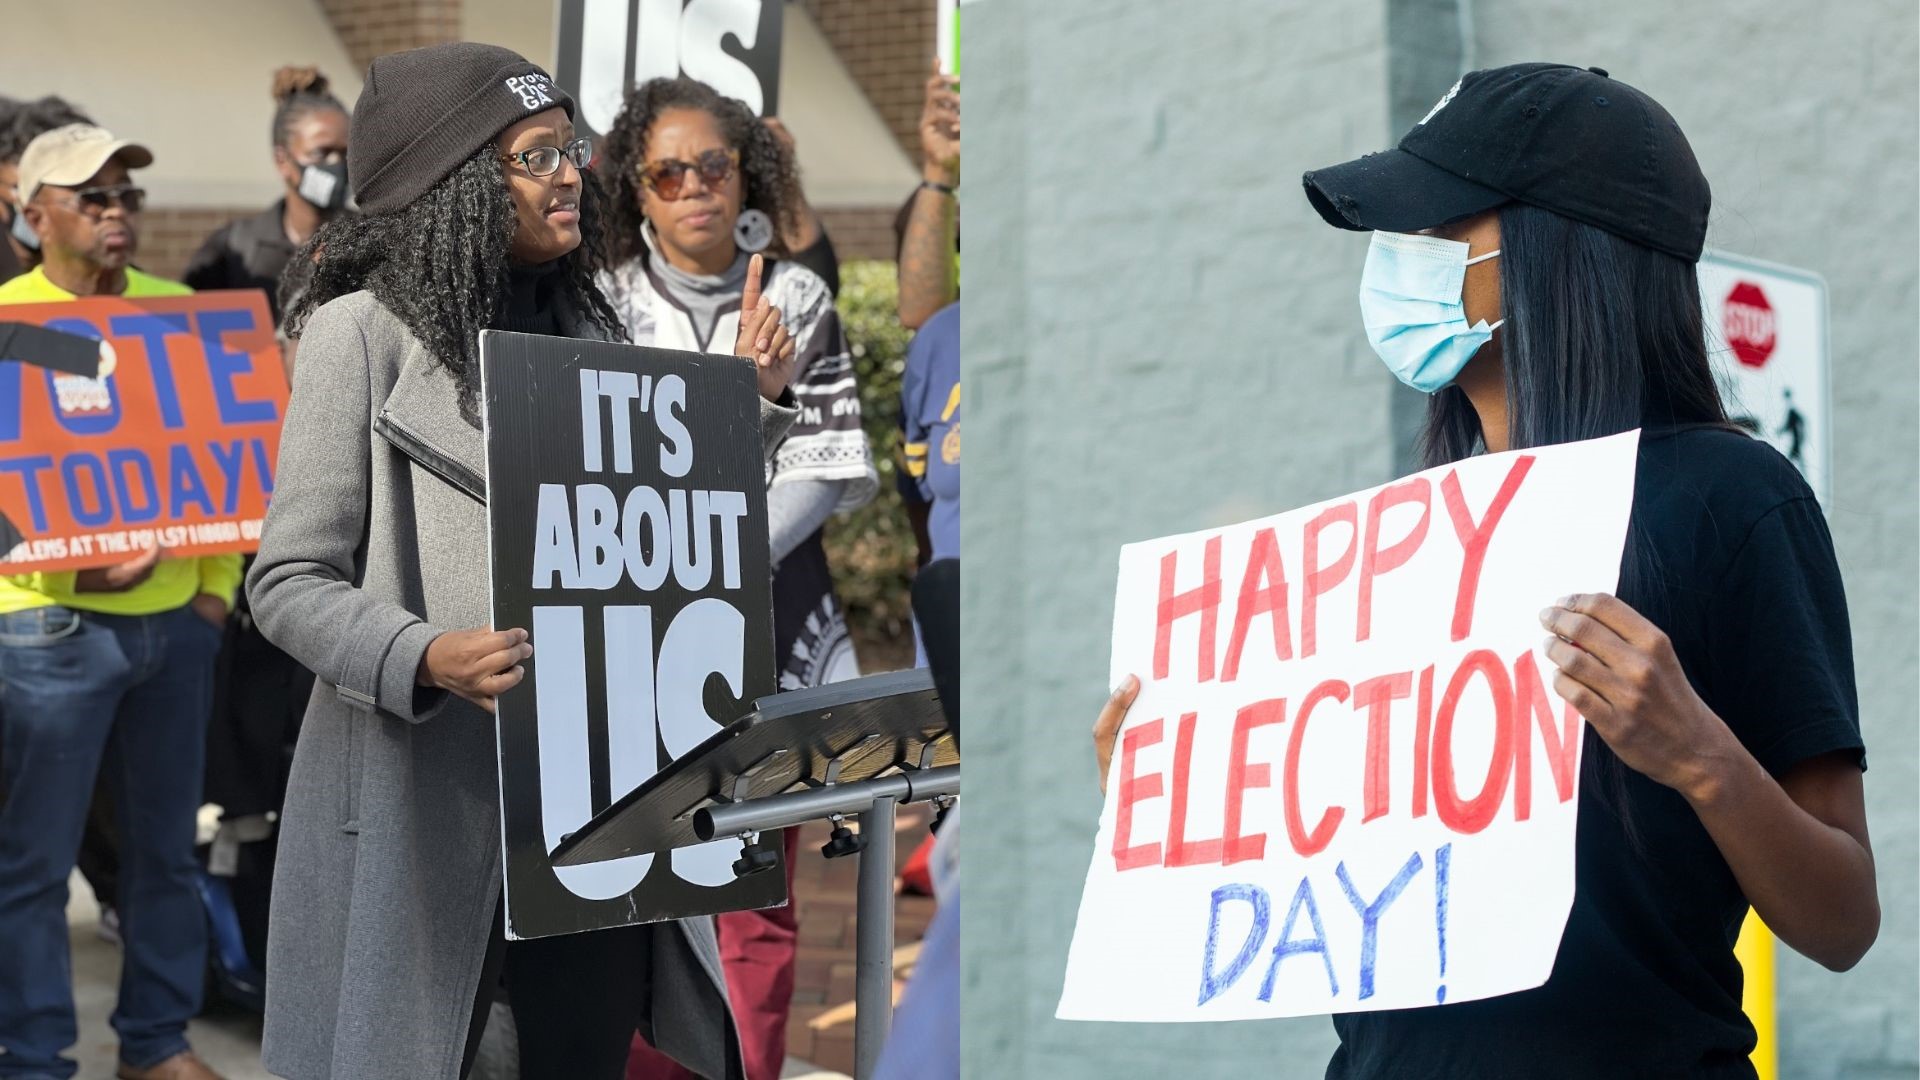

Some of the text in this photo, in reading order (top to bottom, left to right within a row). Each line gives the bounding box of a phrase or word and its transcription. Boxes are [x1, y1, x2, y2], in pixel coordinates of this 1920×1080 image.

[505, 72, 556, 94] Prote
[513, 83, 548, 99] The
[523, 91, 554, 109] GA
[579, 368, 694, 478] IT'S
[0, 438, 274, 533] TODAY!
[532, 482, 748, 591] ABOUT
[70, 534, 93, 557] AT
[95, 531, 131, 554] THE
[1152, 455, 1536, 683] HAPPY
[532, 597, 761, 900] US
[1111, 648, 1580, 872] ELECTION
[1197, 842, 1452, 1007] DAY!
